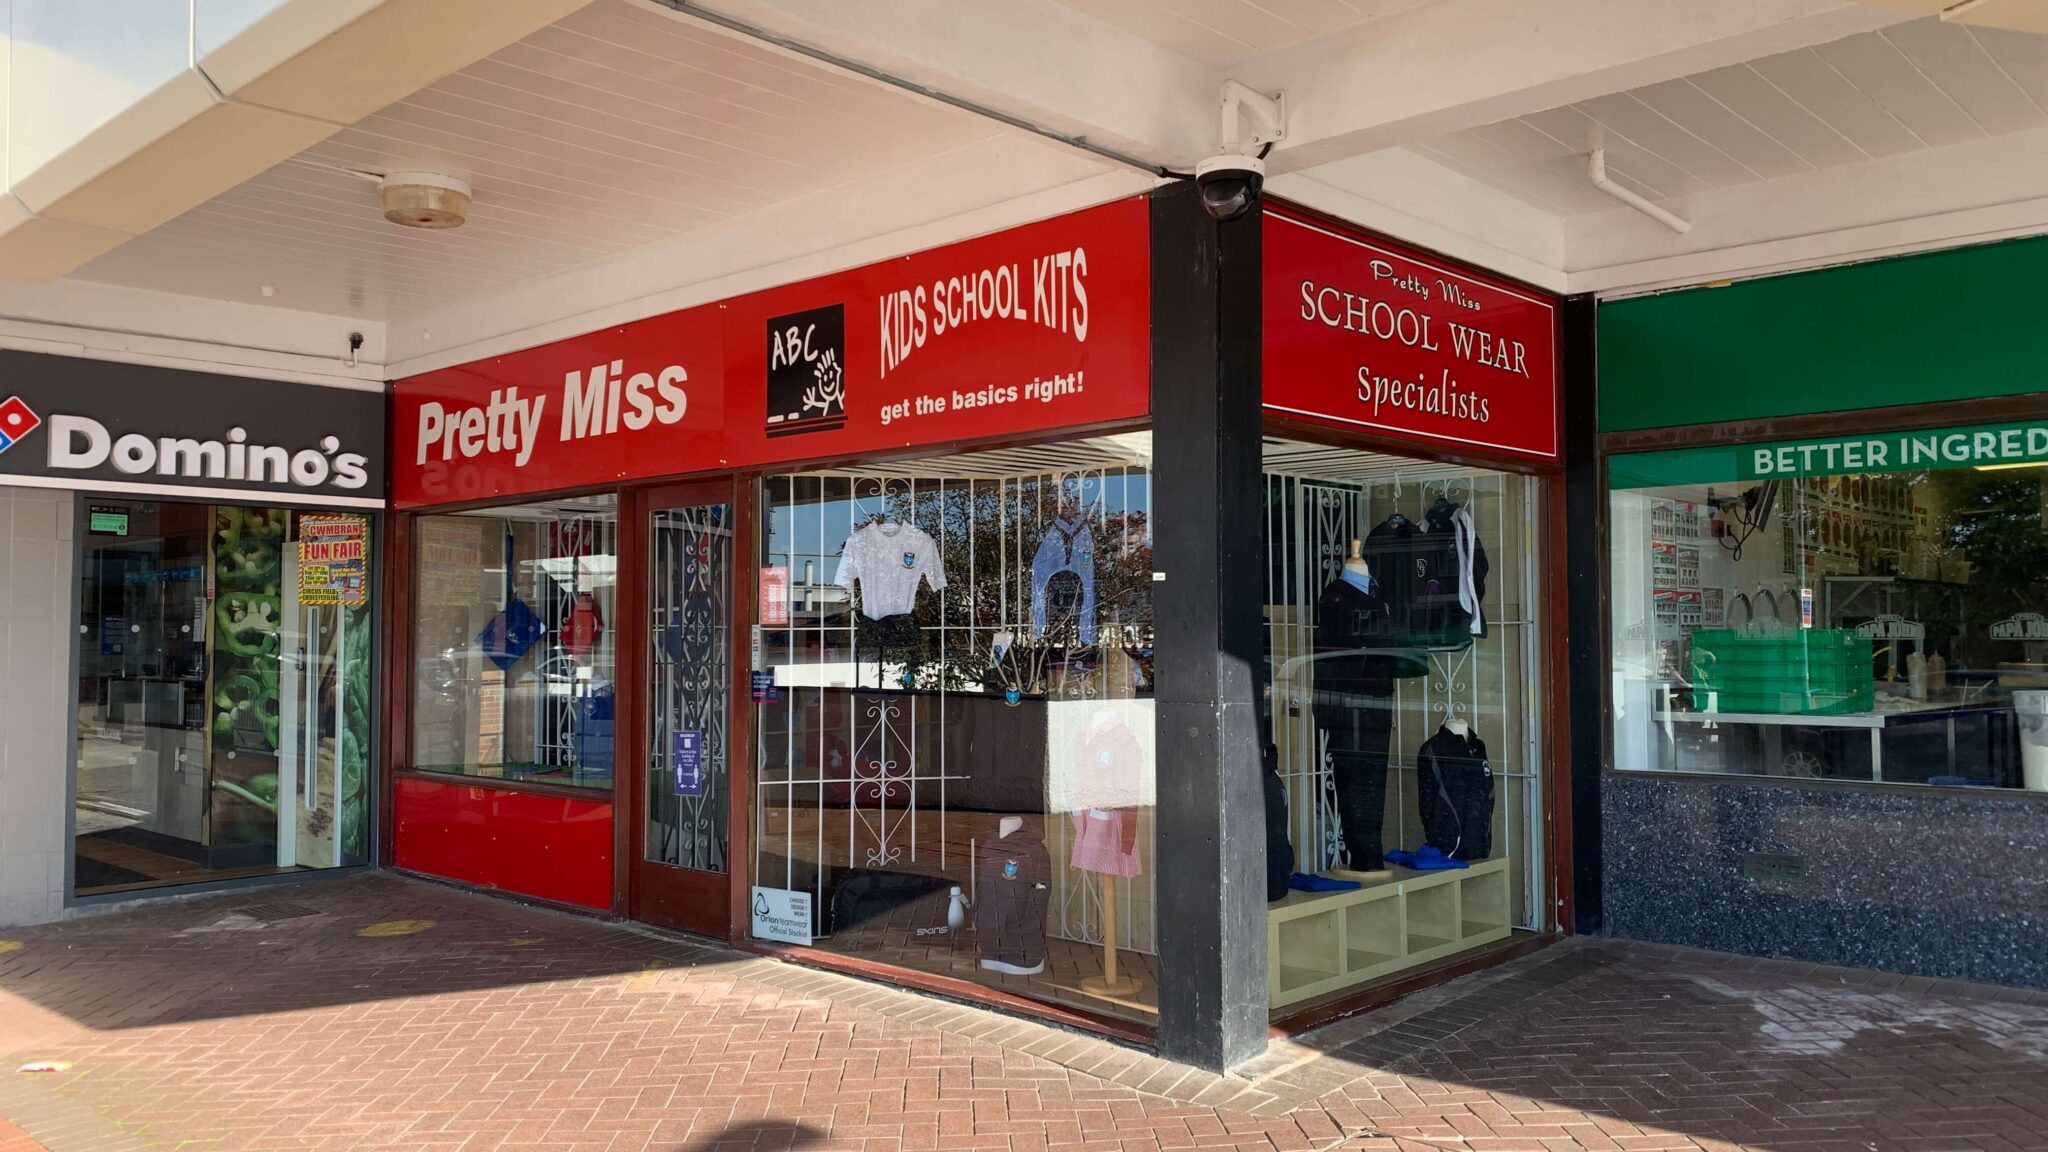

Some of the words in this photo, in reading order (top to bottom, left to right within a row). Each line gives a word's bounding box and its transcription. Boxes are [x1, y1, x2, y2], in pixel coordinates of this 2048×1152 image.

[1369, 259, 1429, 301] Pretty
[1435, 279, 1481, 311] Miss
[880, 284, 928, 380] KIDS
[933, 263, 1028, 336] SCHOOL
[1033, 247, 1089, 342] KITS
[1301, 281, 1438, 352] SCHOOL
[1448, 322, 1530, 379] WEAR
[771, 323, 819, 371] ABC
[416, 386, 547, 467] Pretty
[559, 359, 688, 442] Miss
[880, 399, 910, 426] get
[915, 395, 946, 416] the
[952, 384, 1018, 411] basics
[1024, 371, 1084, 403] right!
[1358, 366, 1490, 423] Specialists
[47, 414, 368, 489] Domino's
[1754, 440, 1889, 475] BETTER
[1900, 428, 2048, 465] INGRED
[304, 544, 329, 559] FUN
[333, 542, 361, 558] FAIR
[310, 525, 358, 535] CWMBRAN
